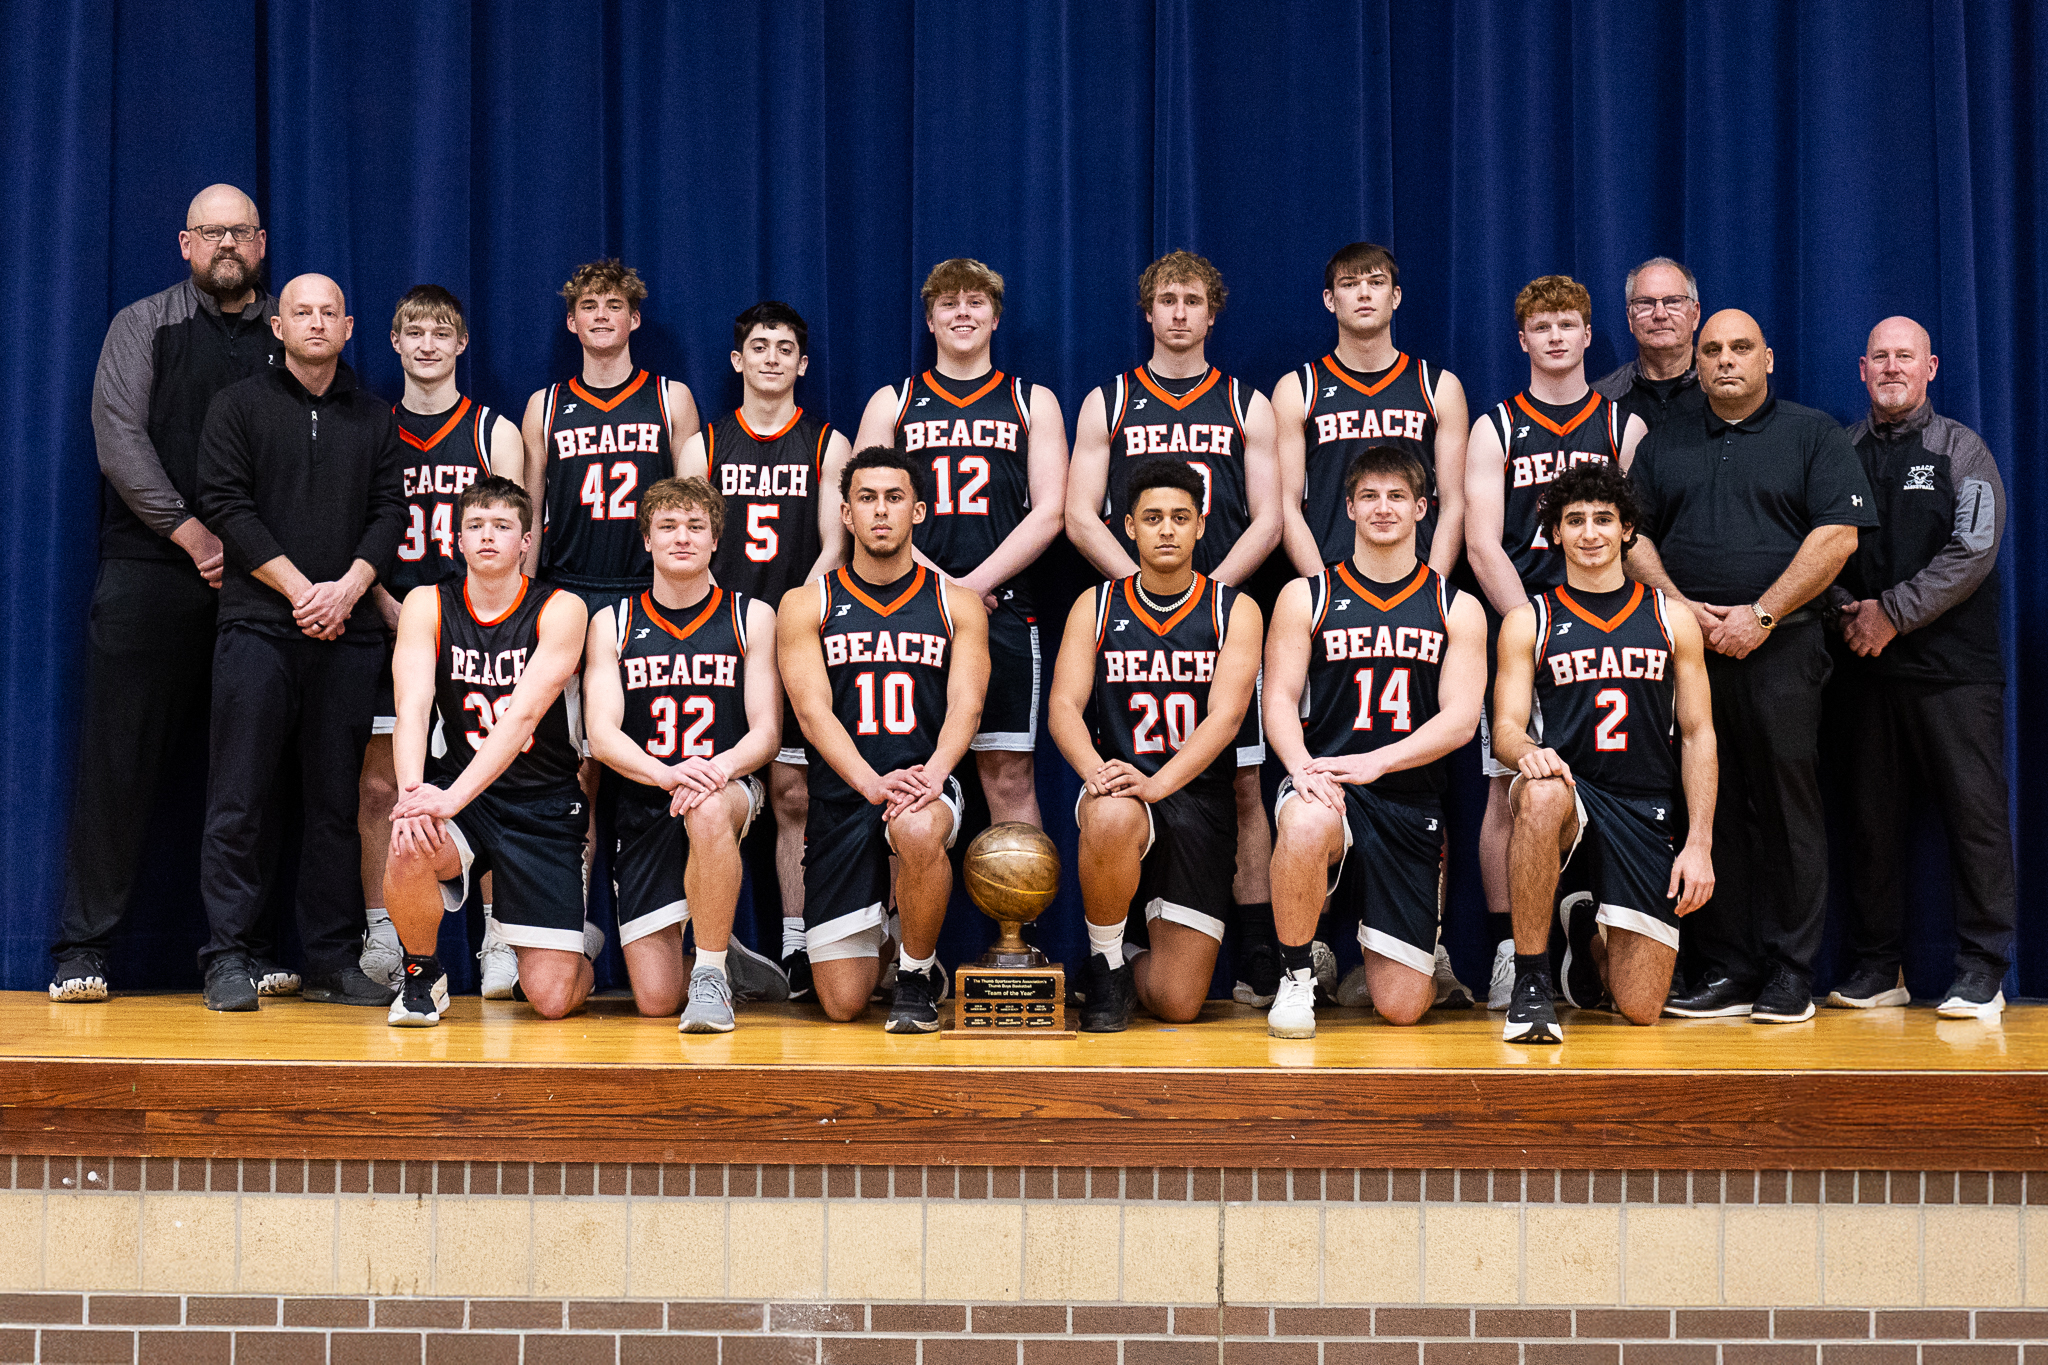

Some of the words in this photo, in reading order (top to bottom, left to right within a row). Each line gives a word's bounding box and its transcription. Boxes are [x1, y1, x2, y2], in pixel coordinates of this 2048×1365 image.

[554, 423, 661, 459] BEACH
[903, 418, 1019, 453] BEACH
[1123, 423, 1234, 456] BEACH
[1315, 408, 1427, 444] BEACH
[403, 464, 478, 498] EACH
[580, 460, 638, 520] 42
[721, 462, 809, 497] BEACH
[931, 455, 991, 516] 12
[397, 502, 454, 562] 34
[745, 503, 779, 562] 5
[823, 630, 946, 668] BEACH
[1322, 625, 1444, 664] BEACH
[624, 654, 737, 691] BEACH
[1104, 650, 1219, 683] BEACH
[1547, 646, 1668, 686] BEACH
[855, 671, 915, 735] 10
[1352, 667, 1412, 733] 14
[1595, 687, 1629, 752] 2
[463, 691, 535, 754] 3
[646, 695, 715, 758] 32
[1128, 691, 1198, 755] 20
